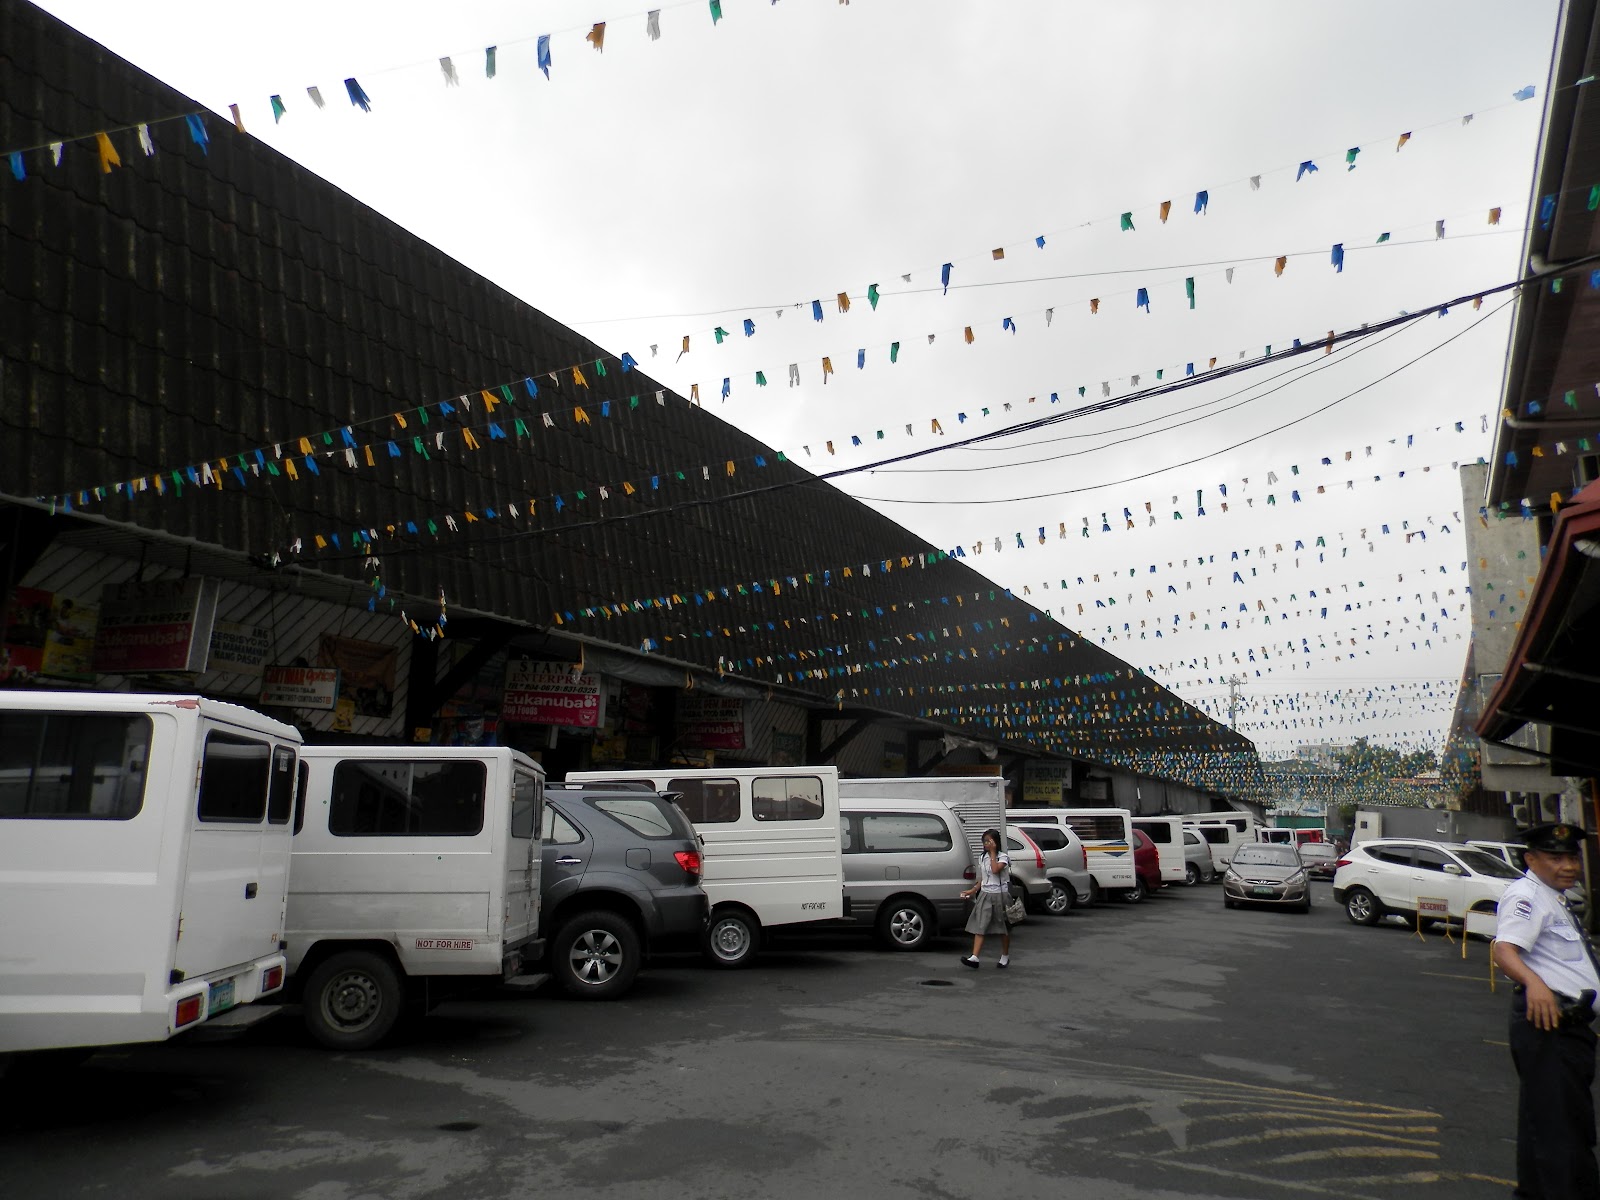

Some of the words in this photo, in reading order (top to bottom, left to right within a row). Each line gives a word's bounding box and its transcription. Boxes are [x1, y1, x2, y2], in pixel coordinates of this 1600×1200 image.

[237, 653, 263, 665] PASAY
[512, 673, 596, 686] ENTERPRSE
[503, 692, 583, 709] Eukanuba
[502, 704, 516, 716] Dog
[517, 705, 538, 716] Foods
[1420, 902, 1447, 911] RESERVED
[417, 940, 434, 948] NOT
[436, 940, 452, 949] FOR
[453, 941, 472, 949] HIRE
